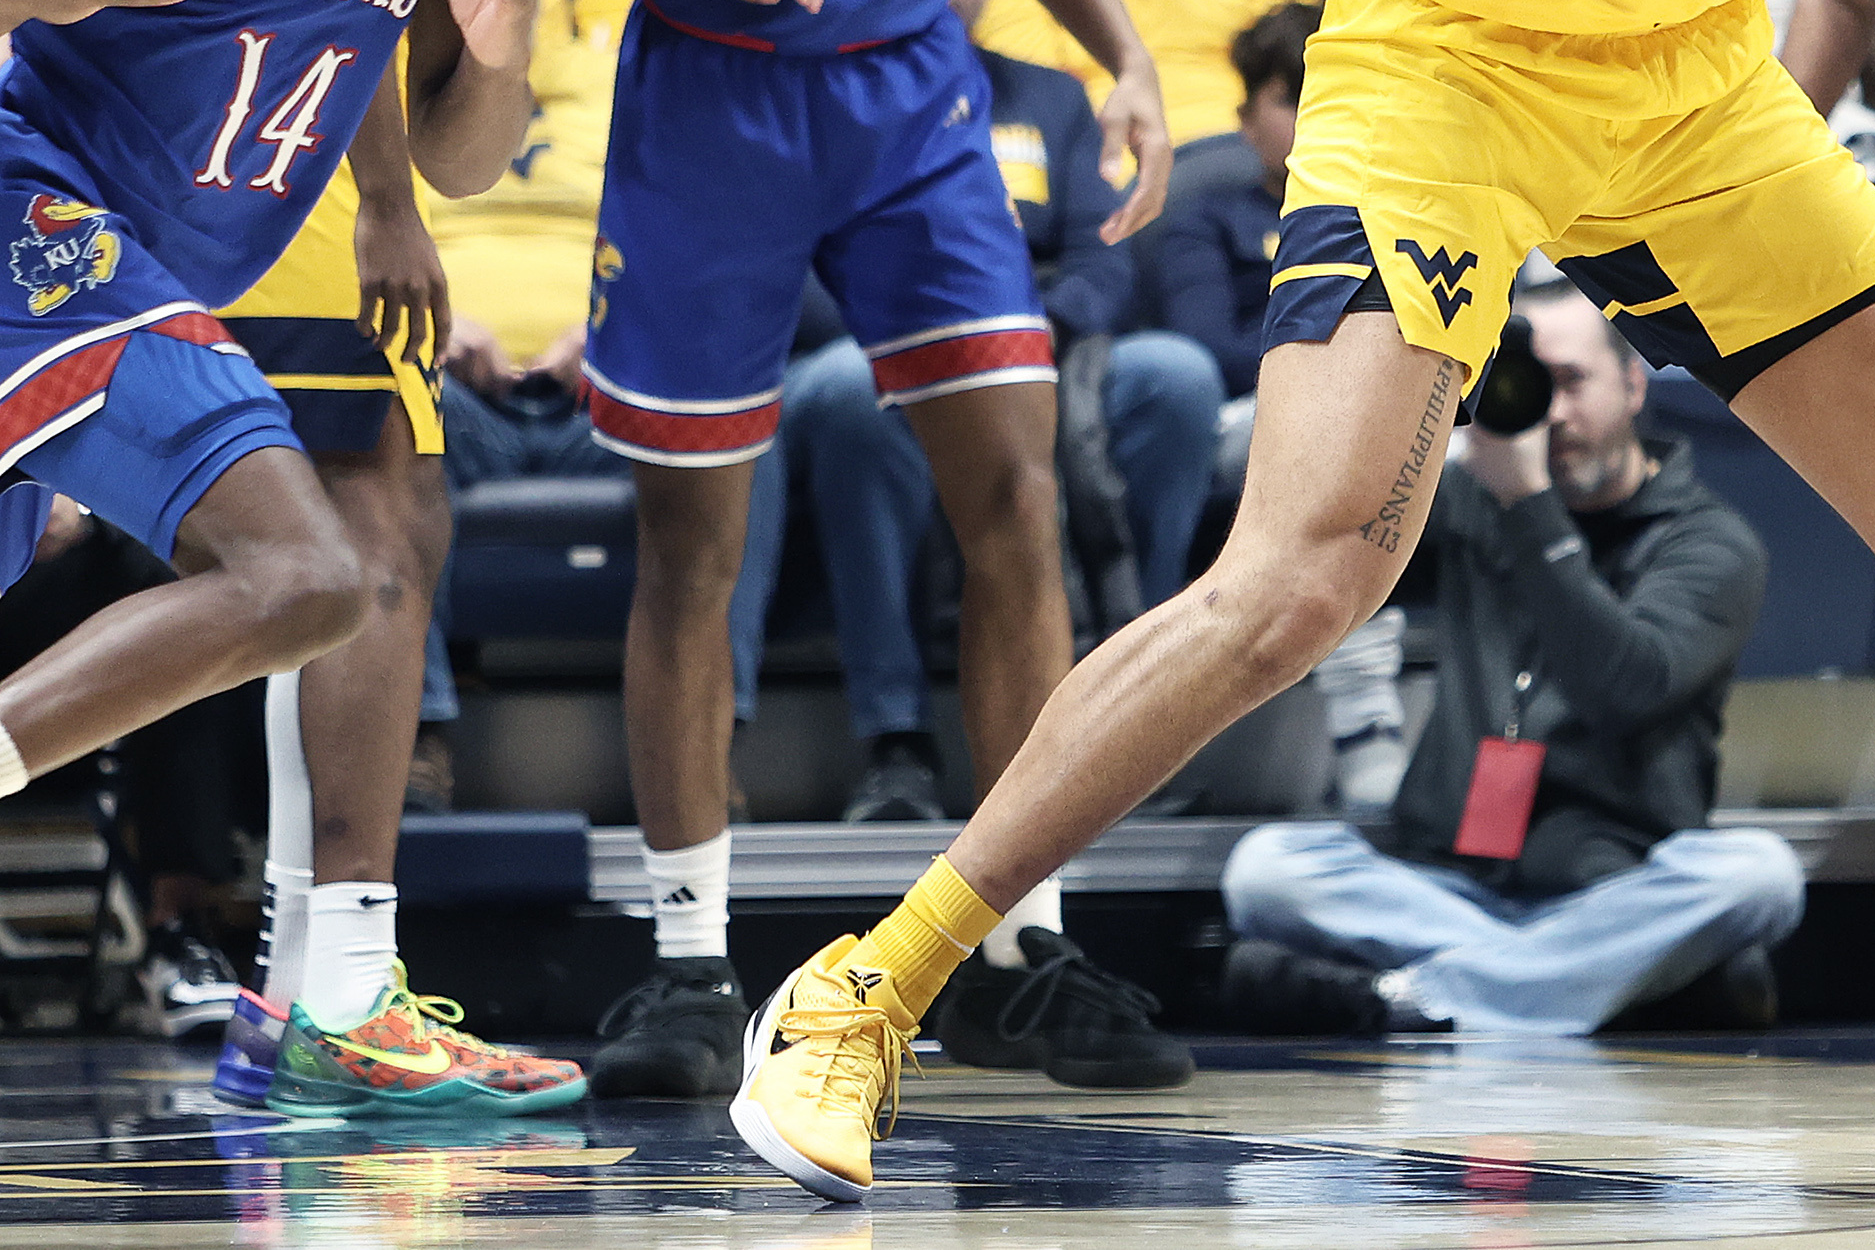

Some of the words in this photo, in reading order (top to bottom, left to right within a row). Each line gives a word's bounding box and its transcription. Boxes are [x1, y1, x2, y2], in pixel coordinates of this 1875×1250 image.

[194, 29, 358, 198] 14
[43, 238, 80, 271] KU
[1378, 367, 1451, 525] PHILIPPIANS
[1360, 519, 1400, 553] 4:13
